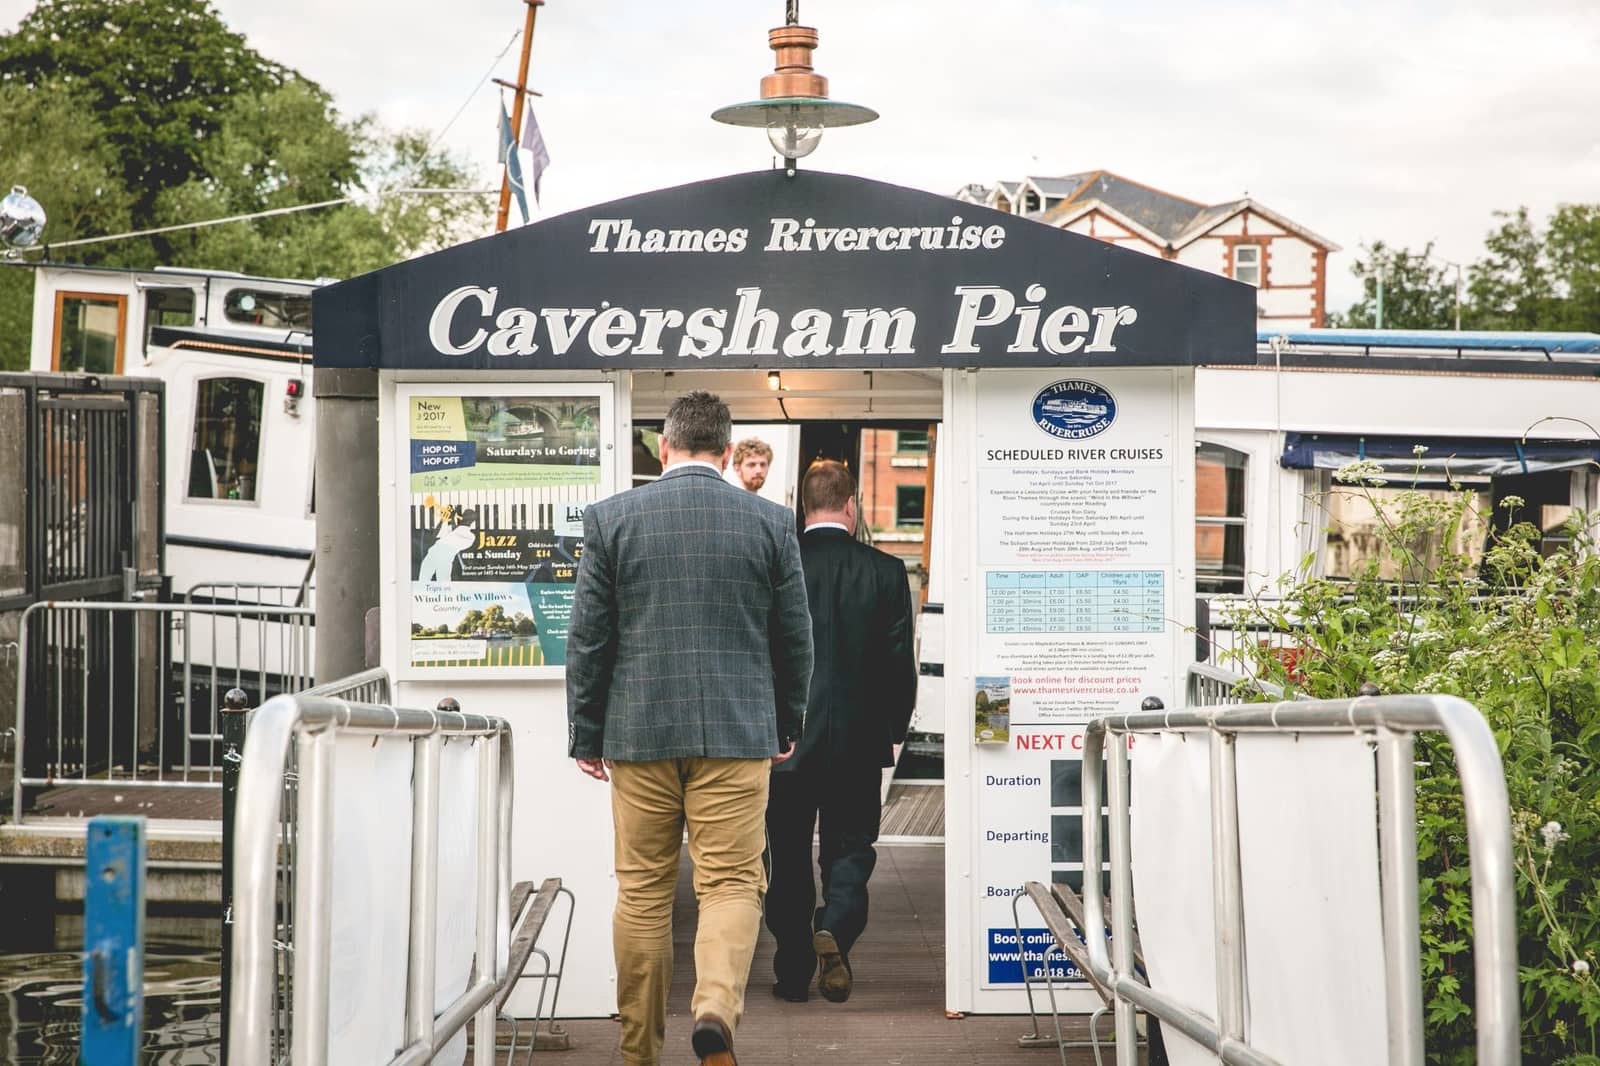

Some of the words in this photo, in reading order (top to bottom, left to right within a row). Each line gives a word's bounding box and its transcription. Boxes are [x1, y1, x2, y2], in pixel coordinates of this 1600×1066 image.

[587, 218, 749, 253] Thames
[763, 216, 1007, 252] Rivercruise
[429, 285, 917, 359] Caversham
[940, 283, 1138, 356] Pier
[1050, 382, 1097, 394] THAMES
[417, 400, 441, 412] New
[422, 411, 446, 421] 2017
[1038, 417, 1111, 439] RIVERCRUISE
[422, 446, 441, 455] HOP
[442, 445, 457, 454] ON
[486, 445, 543, 458] Saturdays
[544, 446, 557, 456] to
[558, 445, 597, 458] Goring
[987, 449, 1064, 461] SCHEDULED
[1067, 449, 1106, 460] RIVER
[1109, 448, 1163, 460] CRUISES
[422, 456, 442, 466] HOP
[442, 456, 461, 465] OFF
[566, 506, 585, 519] Liv
[476, 530, 518, 551] Jazz
[461, 552, 475, 560] on
[485, 549, 522, 562] Sunday
[535, 549, 552, 559] £14
[414, 594, 442, 604] Wind
[444, 594, 455, 603] in
[456, 593, 472, 603] the
[473, 592, 514, 602] Willows
[432, 604, 462, 614] Country
[1034, 676, 1062, 685] online
[1063, 676, 1076, 685] for
[1078, 676, 1115, 685] discount
[1116, 676, 1142, 687] prices
[1013, 686, 1140, 695] www.thamesrivercruise.co.uk
[1016, 734, 1066, 751] NEXT
[986, 774, 1041, 786] Duration
[986, 829, 1049, 844] Departing
[987, 885, 1027, 897] Board
[1027, 932, 1057, 944] onlin
